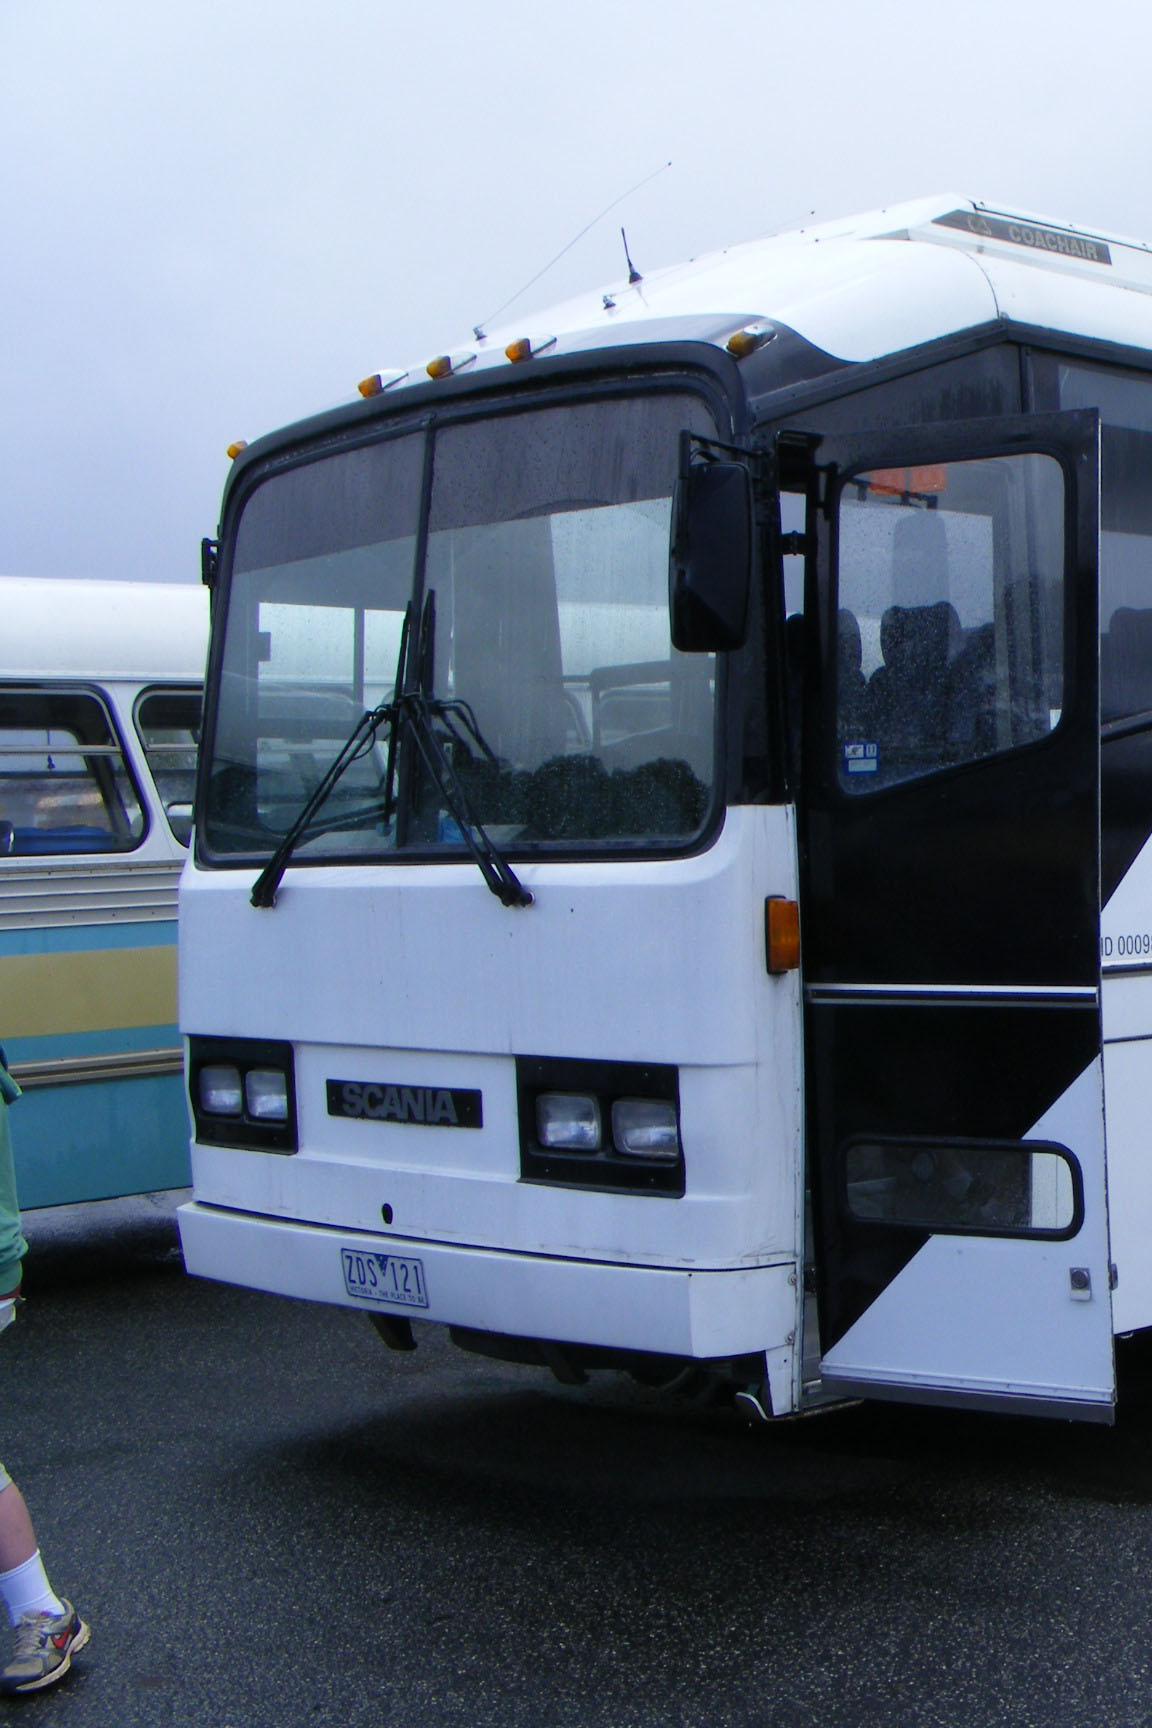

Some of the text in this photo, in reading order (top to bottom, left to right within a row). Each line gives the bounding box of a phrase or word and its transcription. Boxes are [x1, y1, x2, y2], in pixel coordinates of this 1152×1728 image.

[1008, 224, 1099, 261] COACHAIR
[342, 1083, 459, 1124] SCANIA
[345, 1254, 422, 1295] ZDS 121
